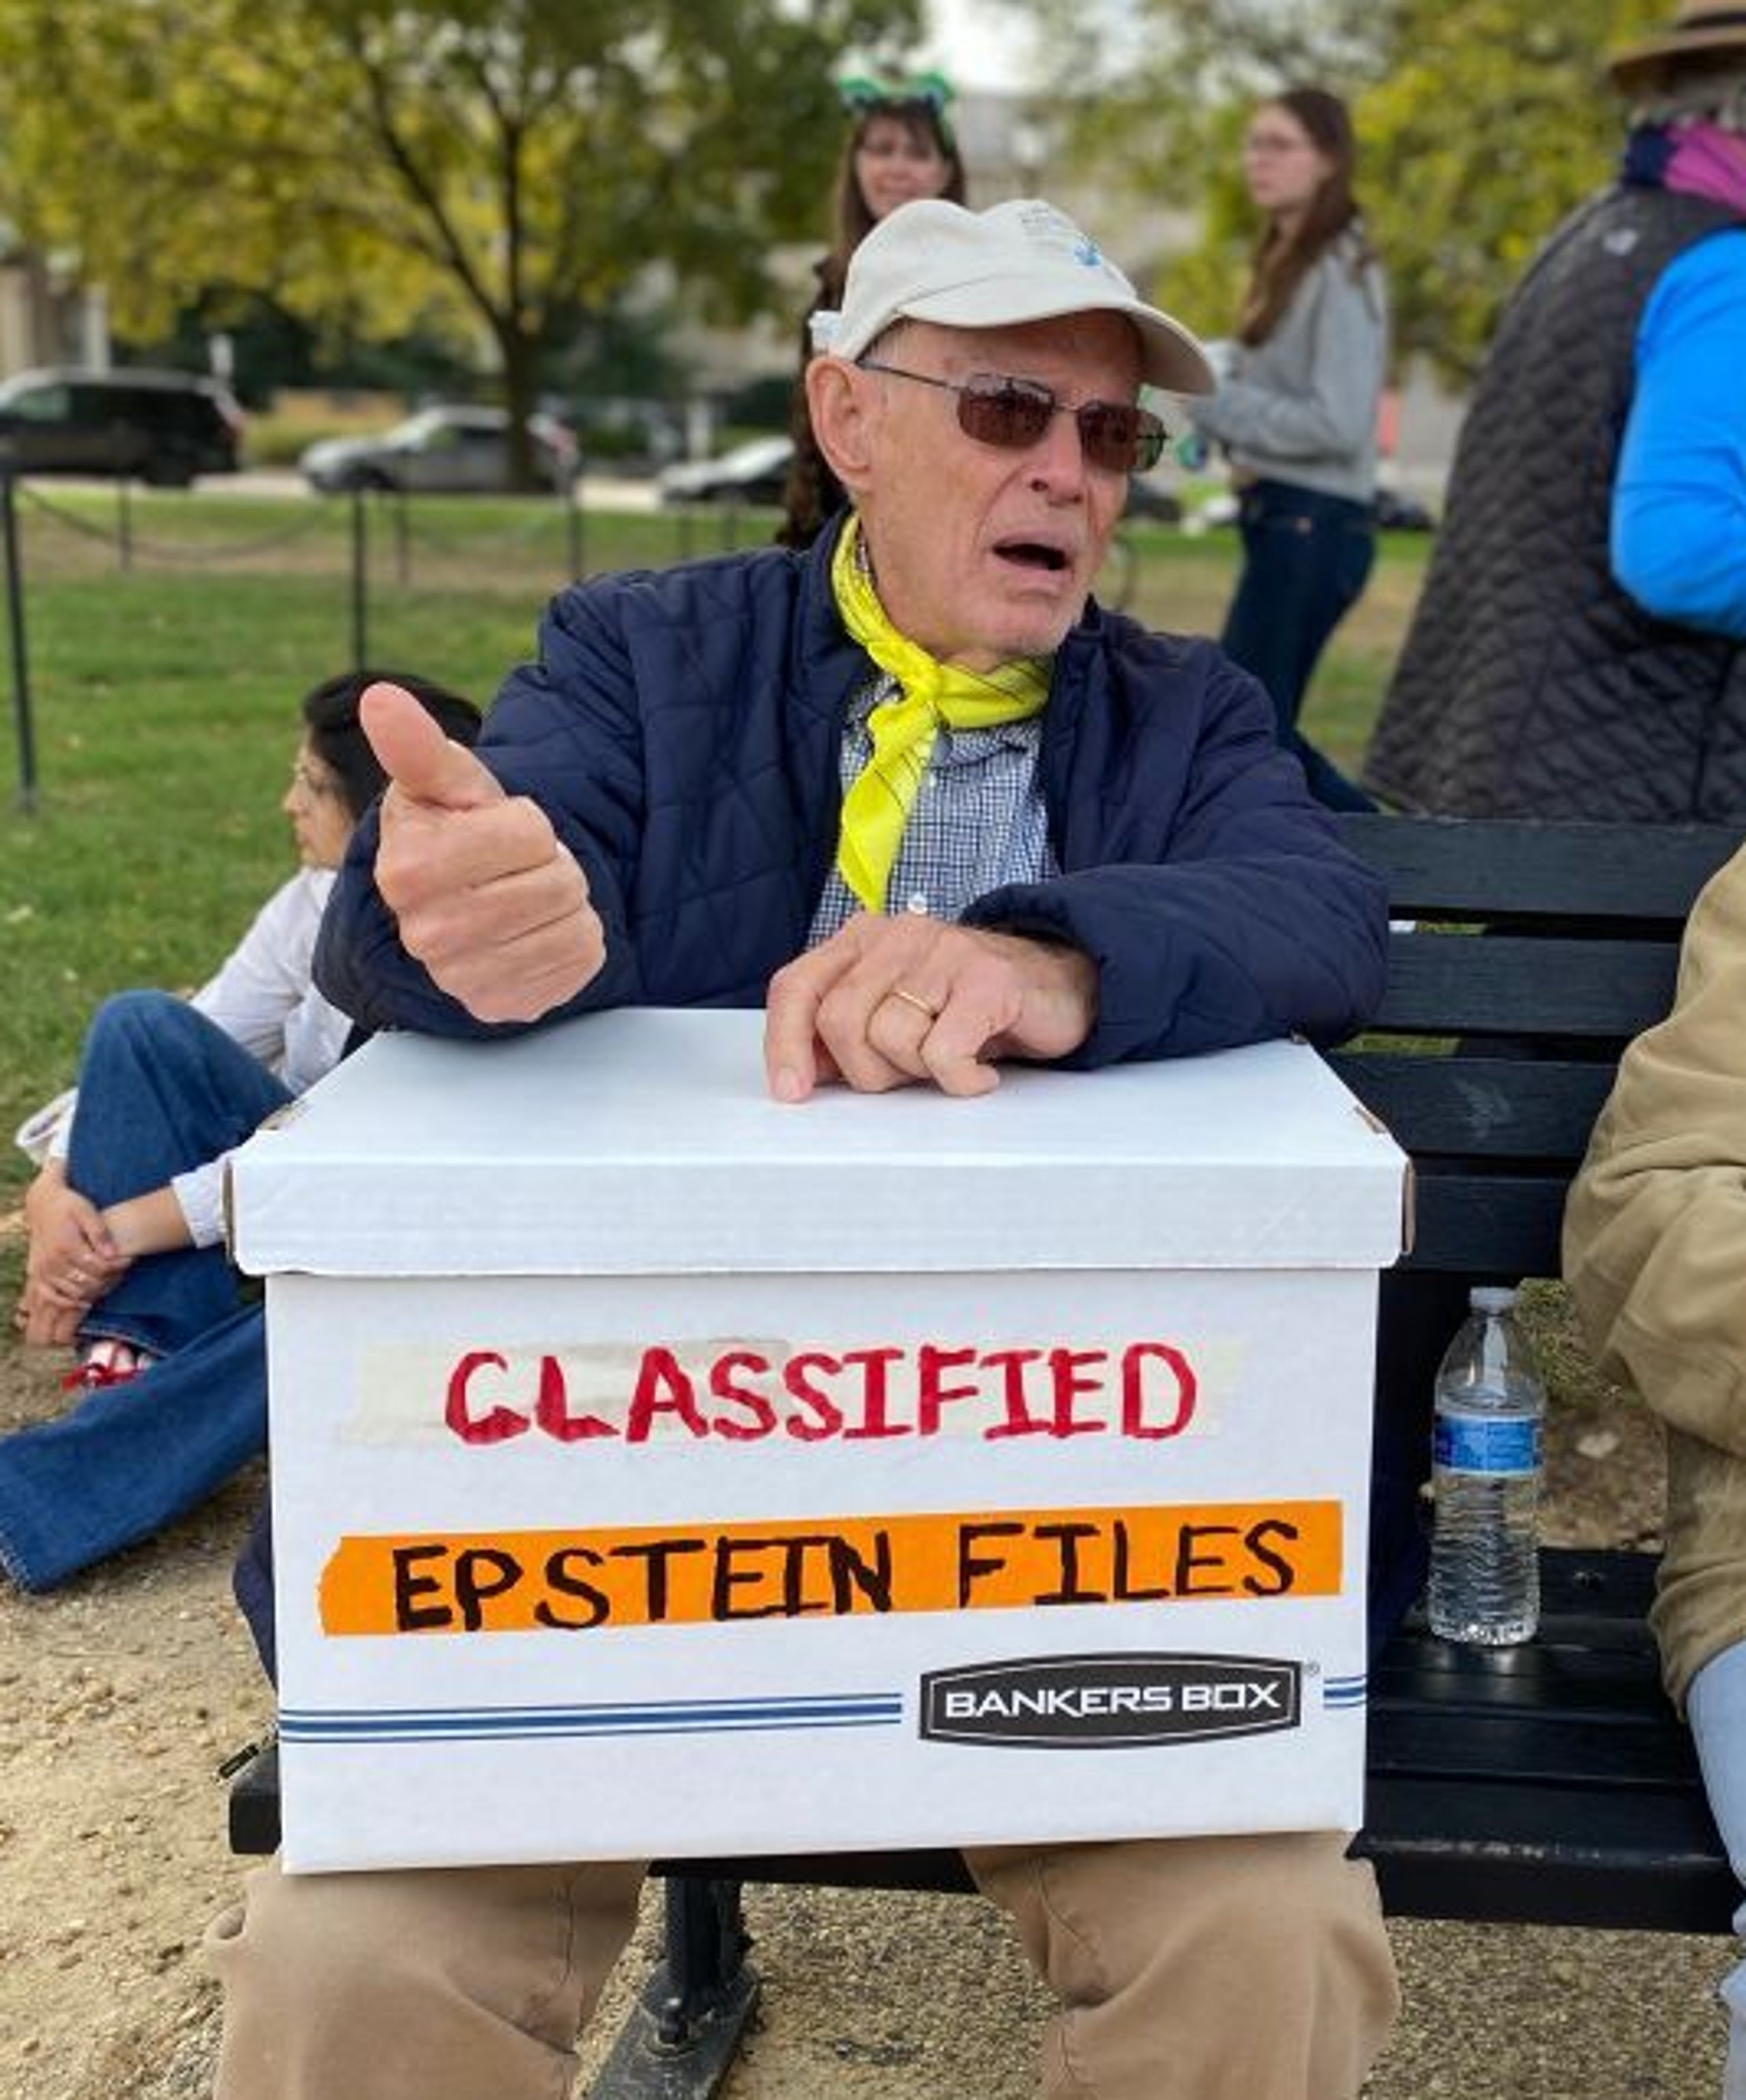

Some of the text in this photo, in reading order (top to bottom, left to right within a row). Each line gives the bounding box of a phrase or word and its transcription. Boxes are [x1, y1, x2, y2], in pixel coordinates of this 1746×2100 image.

[445, 1342, 1198, 1445] CLASSIFIED
[392, 1520, 1298, 1632] EPSTEIN FILES
[945, 1681, 1282, 1718] BANKERS BOX
